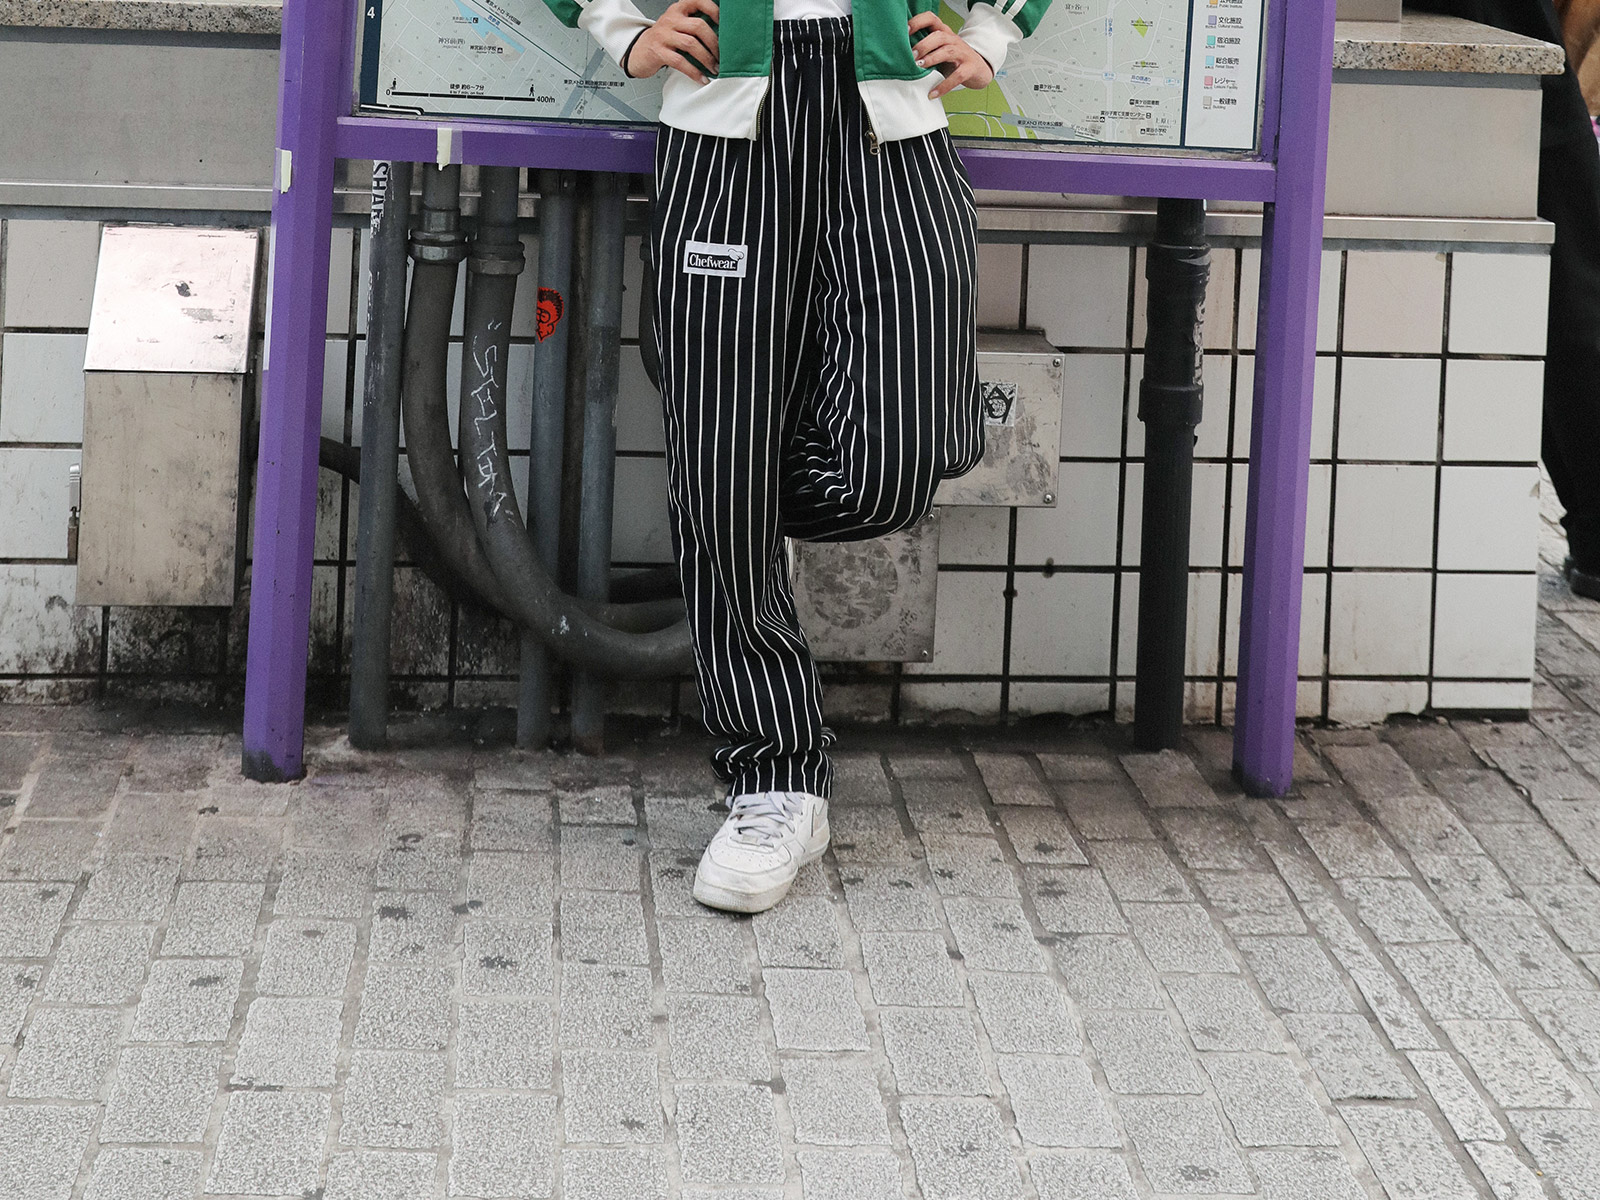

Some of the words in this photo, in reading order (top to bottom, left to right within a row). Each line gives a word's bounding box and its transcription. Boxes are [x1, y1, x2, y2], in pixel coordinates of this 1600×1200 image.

[367, 7, 375, 18] 4
[1219, 17, 1242, 25] 文化施設
[1217, 36, 1241, 45] 宿泊施設
[1215, 77, 1236, 86] レジャー
[1213, 98, 1237, 106] 一般建物
